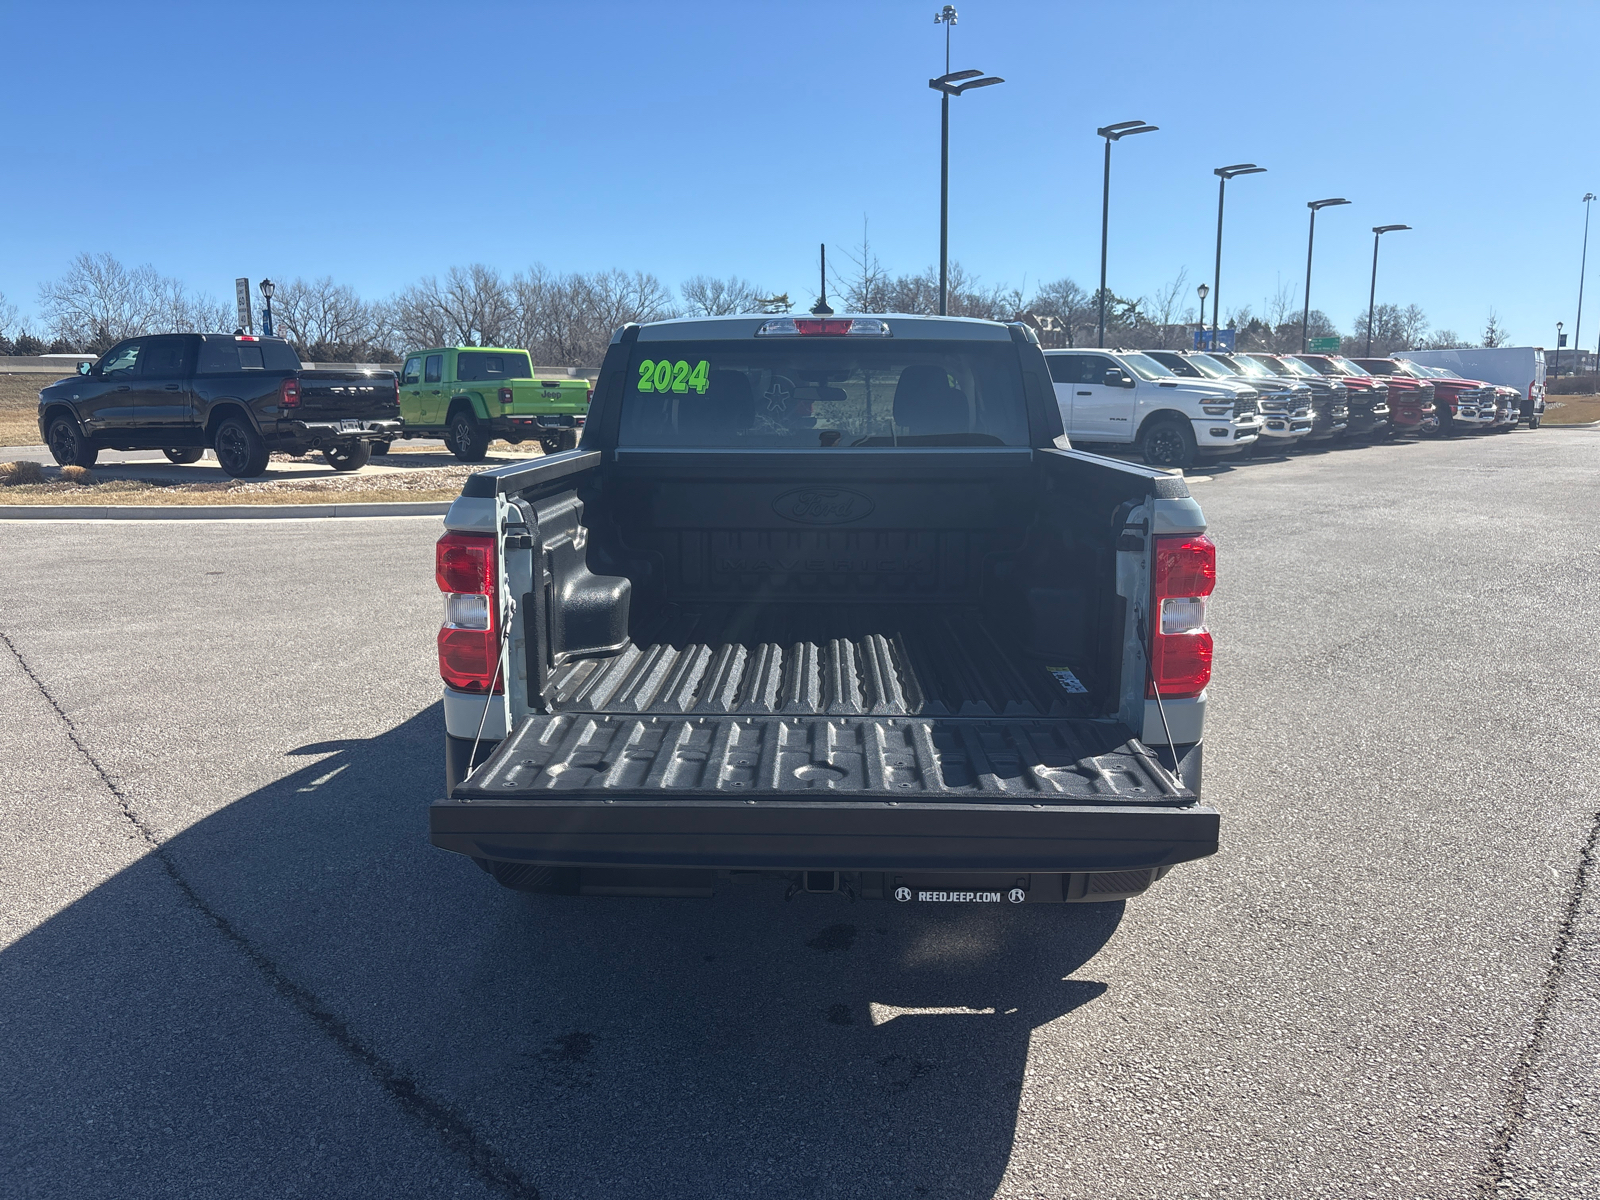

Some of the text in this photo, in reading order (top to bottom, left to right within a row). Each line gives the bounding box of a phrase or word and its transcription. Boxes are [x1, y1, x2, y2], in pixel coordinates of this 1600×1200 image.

[637, 359, 710, 395] 2024
[541, 389, 562, 400] Jeep
[791, 491, 854, 518] Ford
[721, 557, 925, 573] MAVERICK
[918, 891, 1001, 903] REEDJEEP.COM
